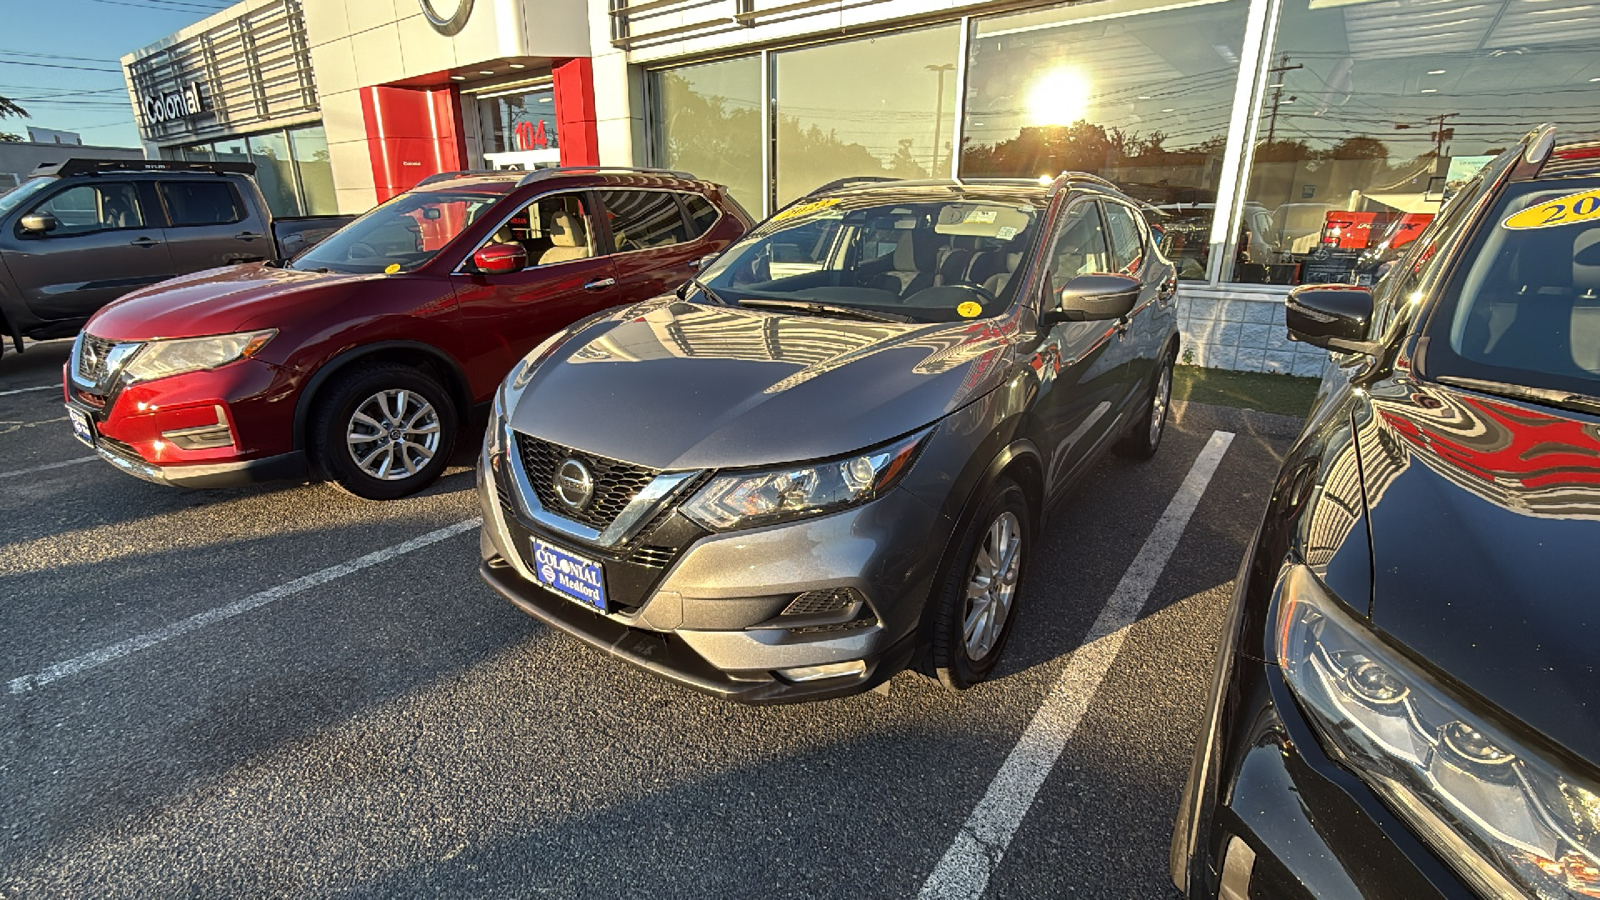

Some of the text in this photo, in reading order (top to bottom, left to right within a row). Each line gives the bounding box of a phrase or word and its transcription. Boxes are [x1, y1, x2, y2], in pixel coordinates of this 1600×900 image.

[145, 82, 201, 124] Colonial
[515, 119, 547, 151] 104
[1540, 196, 1600, 224] 20
[536, 549, 601, 587] COLONIAL
[559, 573, 600, 601] Medford
